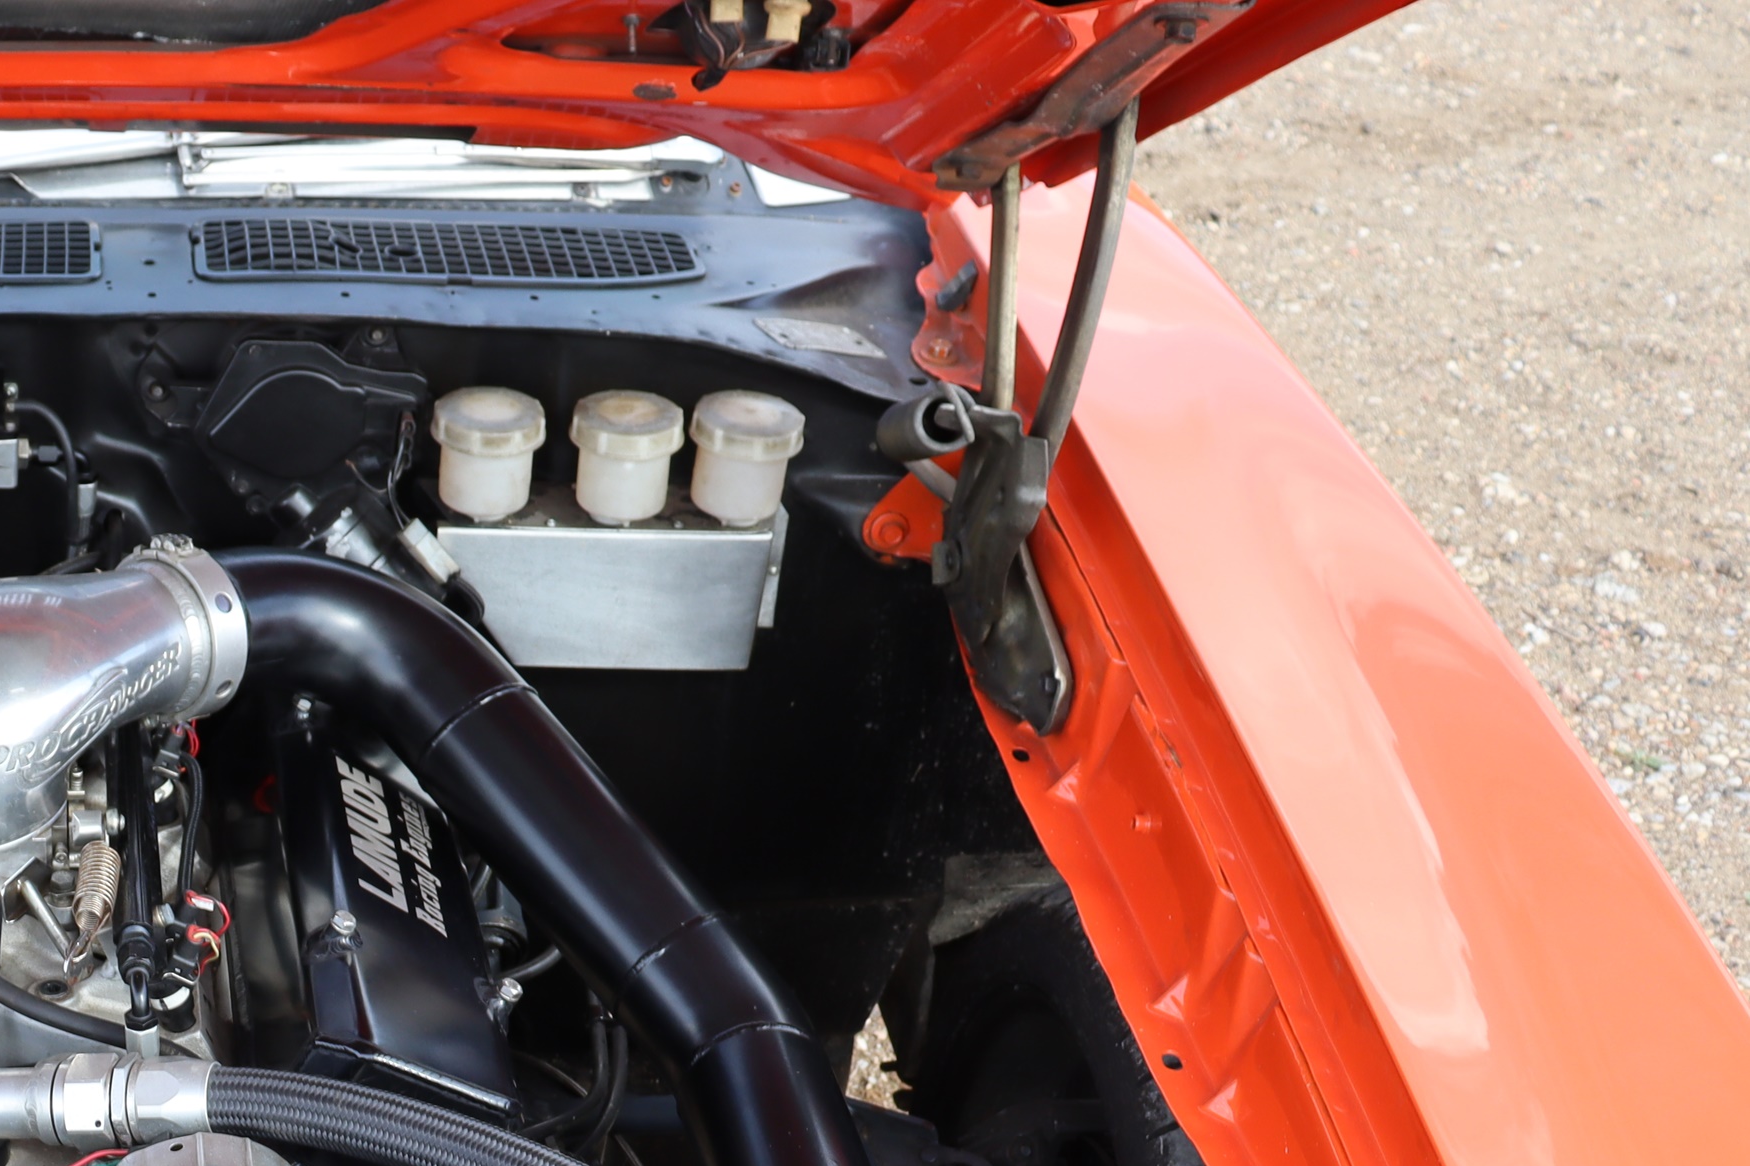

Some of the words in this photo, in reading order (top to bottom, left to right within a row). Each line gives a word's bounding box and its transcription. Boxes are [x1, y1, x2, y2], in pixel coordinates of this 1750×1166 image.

[335, 755, 409, 913] LAMUDE
[397, 791, 432, 867] Engines
[411, 863, 448, 938] Racing
